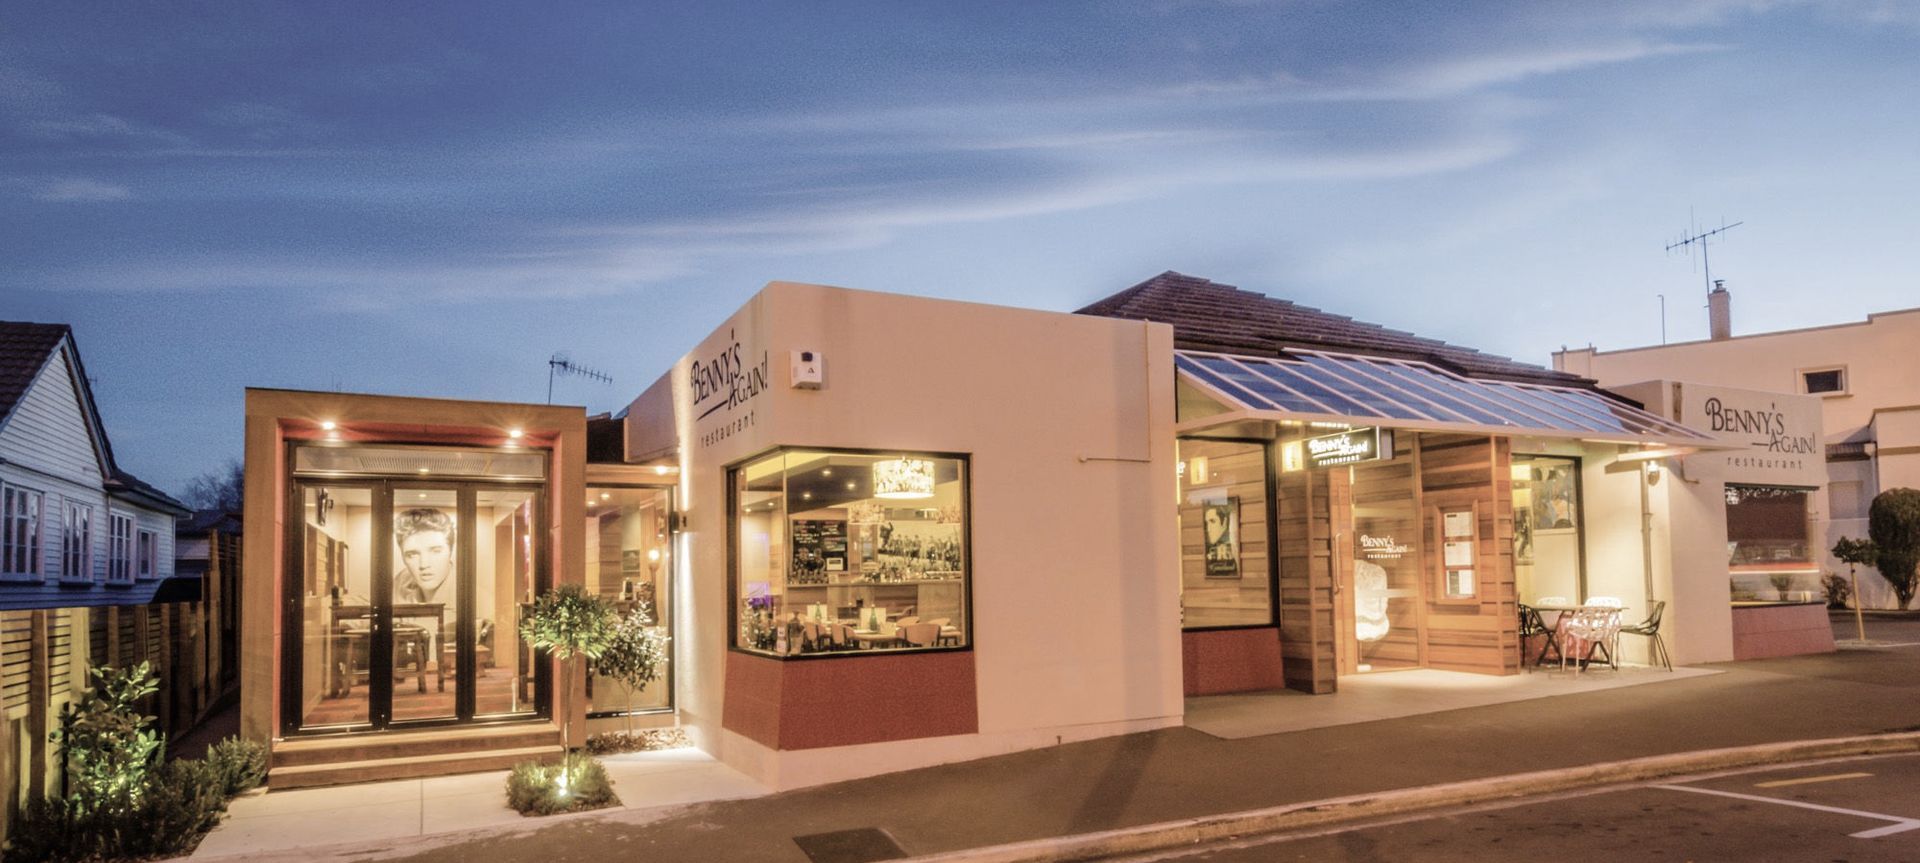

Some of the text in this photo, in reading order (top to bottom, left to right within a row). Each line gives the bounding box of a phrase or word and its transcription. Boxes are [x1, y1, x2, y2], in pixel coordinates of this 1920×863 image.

[691, 328, 741, 406] BENNY'S
[727, 350, 768, 411] AGAIN!
[701, 410, 755, 448] restaurant
[1705, 397, 1784, 435] BENNY'S
[1768, 429, 1816, 454] AGAIN!
[1728, 457, 1802, 469] restaurant
